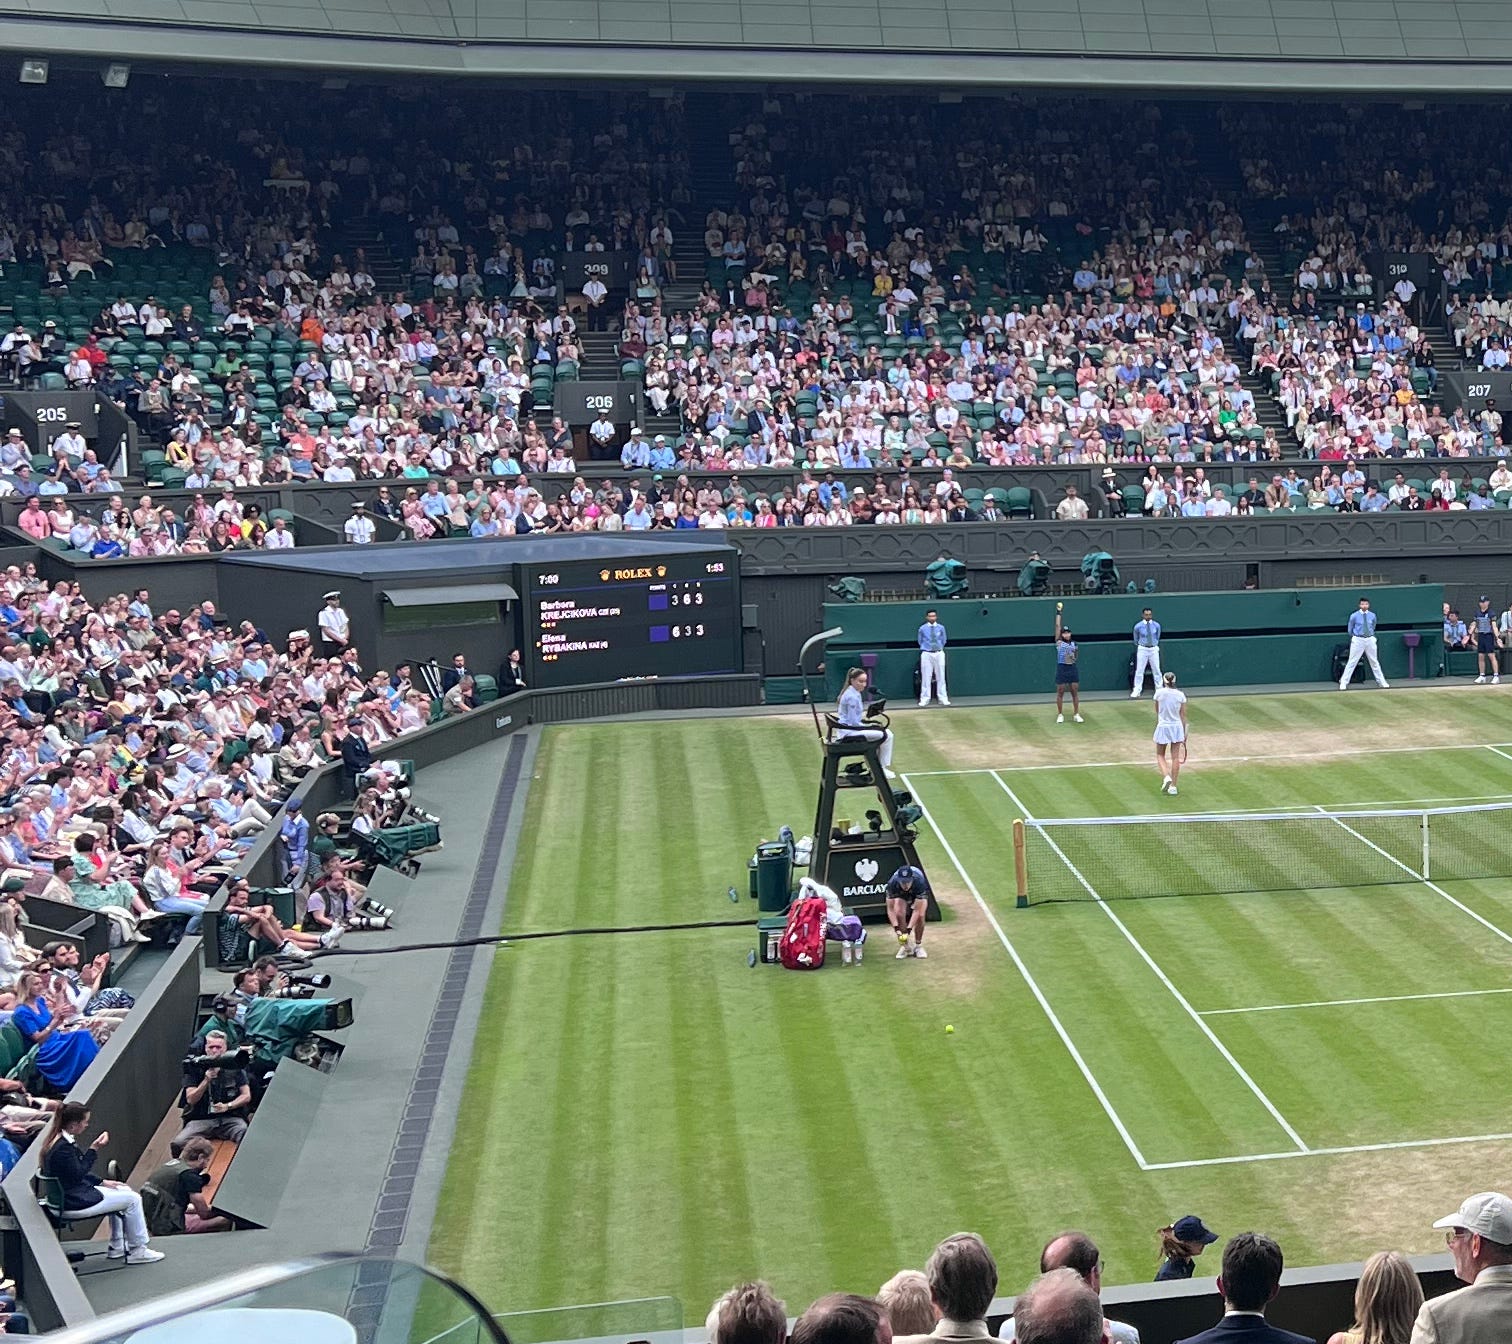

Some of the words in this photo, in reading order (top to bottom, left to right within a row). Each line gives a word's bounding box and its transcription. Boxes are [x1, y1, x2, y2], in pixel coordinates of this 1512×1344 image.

[1468, 384, 1491, 397] 207
[585, 395, 613, 408] 206
[36, 407, 67, 422] 205
[614, 567, 652, 580] ROLEX
[671, 594, 679, 605] 3
[683, 593, 691, 605] 6
[695, 592, 703, 605] 3
[540, 600, 575, 611] Barbora
[540, 608, 598, 620] KREJCIKOVA
[672, 625, 680, 638] 6
[684, 625, 692, 636] 3
[696, 624, 704, 636] 3
[541, 634, 566, 643] Elena
[843, 884, 888, 897] BARCLAY
